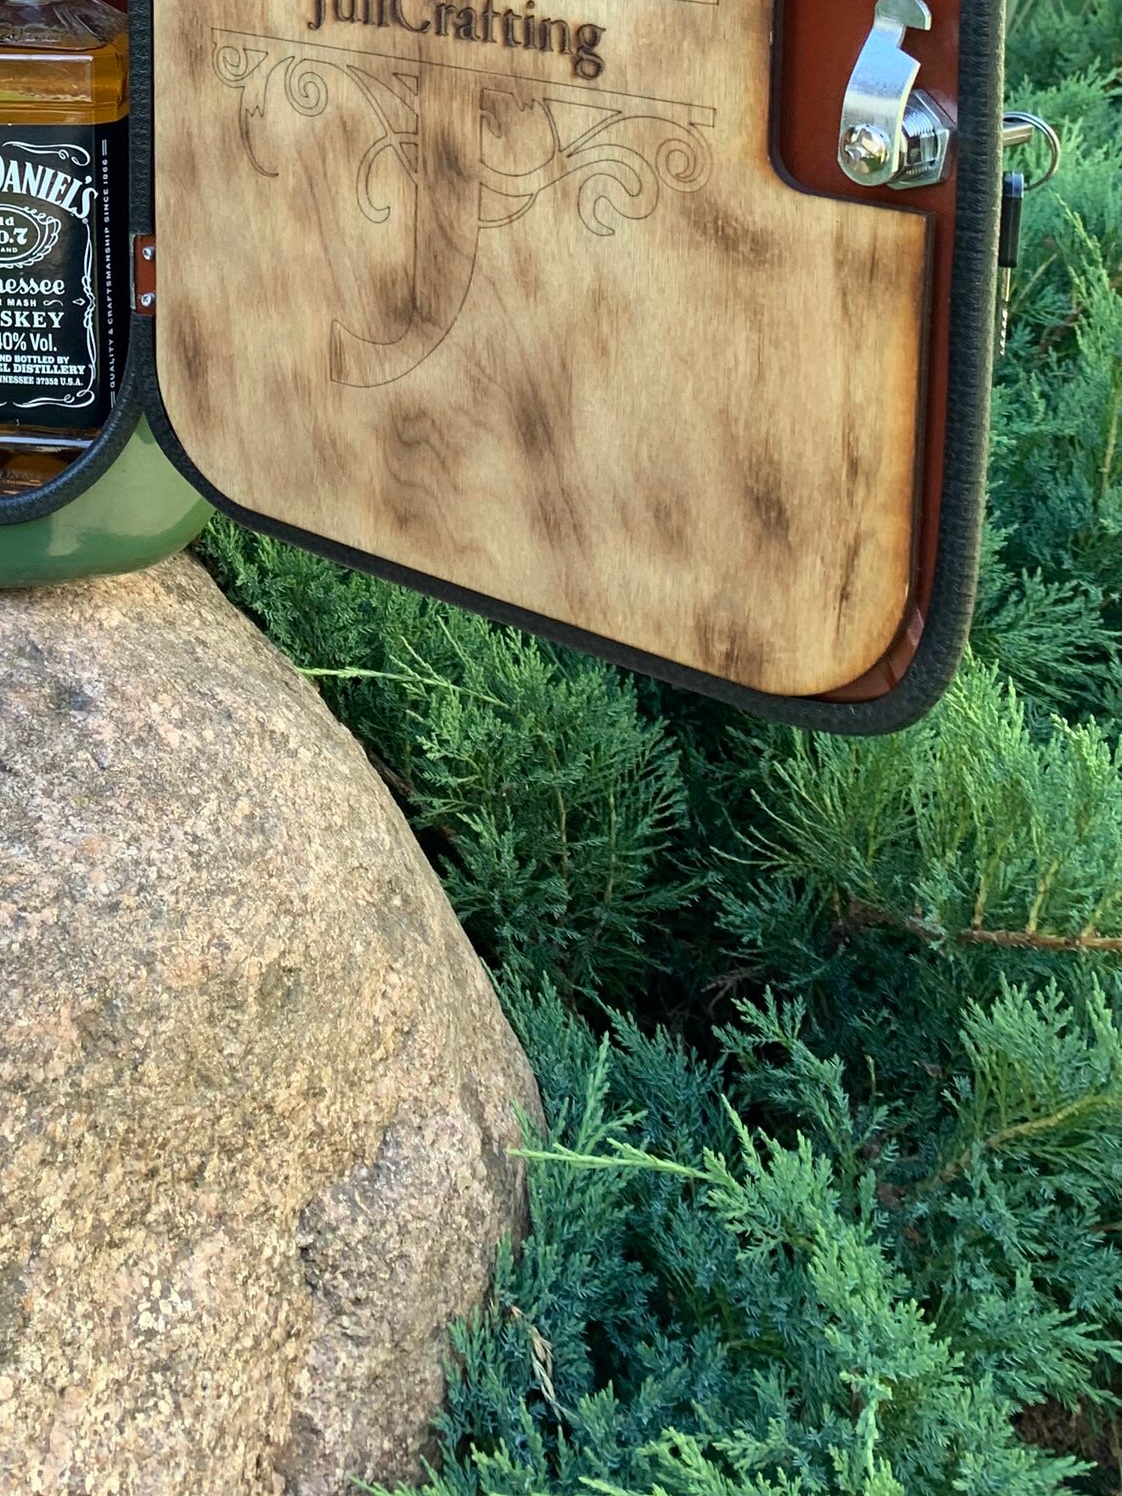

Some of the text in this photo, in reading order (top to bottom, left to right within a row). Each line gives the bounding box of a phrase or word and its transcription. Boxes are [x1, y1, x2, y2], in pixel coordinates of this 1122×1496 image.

[104, 227, 113, 325] CRAFTSMANSHIP
[7, 298, 37, 307] MASH
[30, 333, 58, 352] Vol.
[14, 354, 54, 364] BOTTLED
[57, 356, 69, 364] BY
[107, 339, 115, 388] QUALITY
[13, 363, 86, 375] DISTILLERY
[35, 376, 59, 386] 37352
[60, 377, 84, 386] U.S.A.
